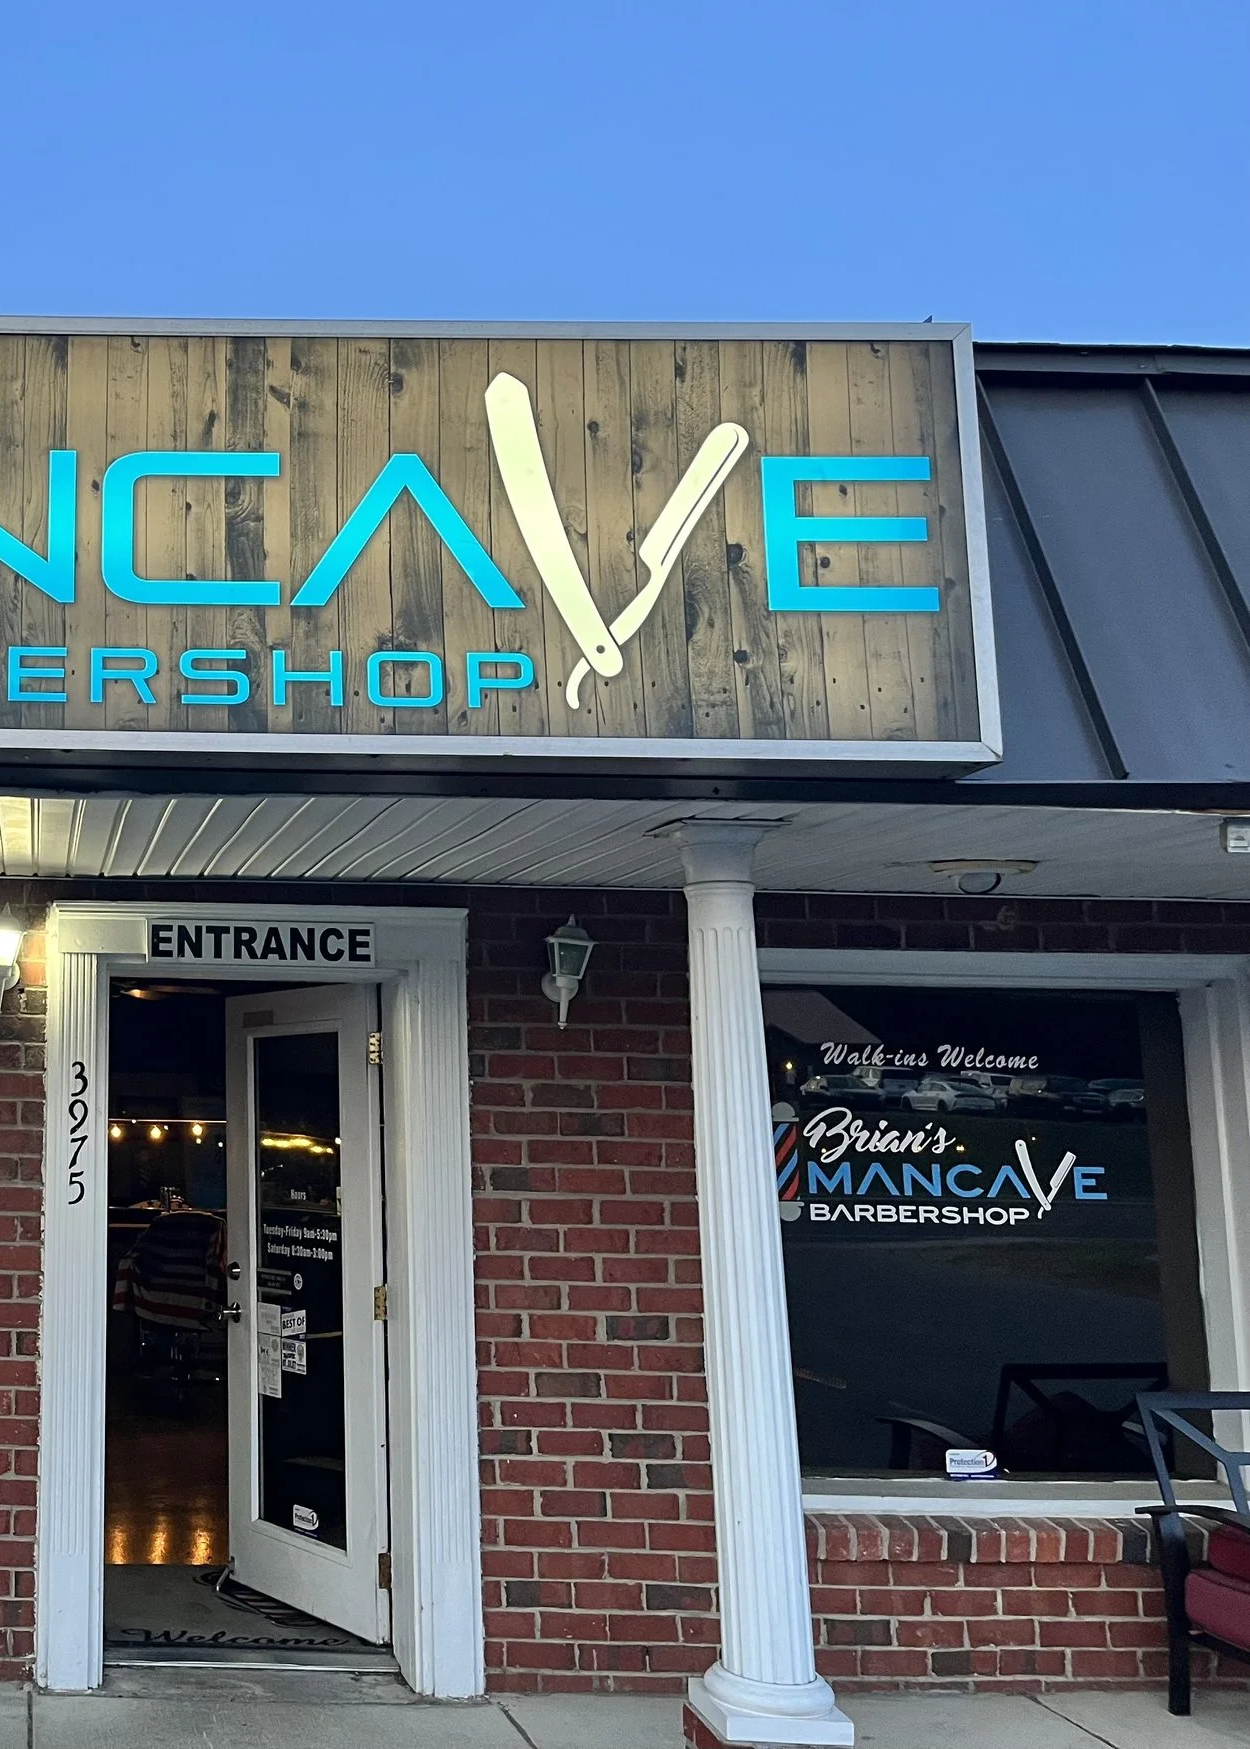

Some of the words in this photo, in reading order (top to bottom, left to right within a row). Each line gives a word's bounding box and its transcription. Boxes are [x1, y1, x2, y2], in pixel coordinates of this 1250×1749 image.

[150, 923, 372, 963] ENTRANCE
[820, 1041, 929, 1068] Walk-ins
[937, 1044, 1040, 1071] Welcome
[67, 1061, 89, 1205] 3975
[802, 1106, 957, 1163] Brian's
[807, 1139, 1108, 1219] MANCAVE
[809, 1203, 1031, 1226] BARBERSHOP
[282, 1318, 296, 1329] BEST
[949, 1457, 984, 1466] Protection
[121, 1628, 349, 1647] Welcome
